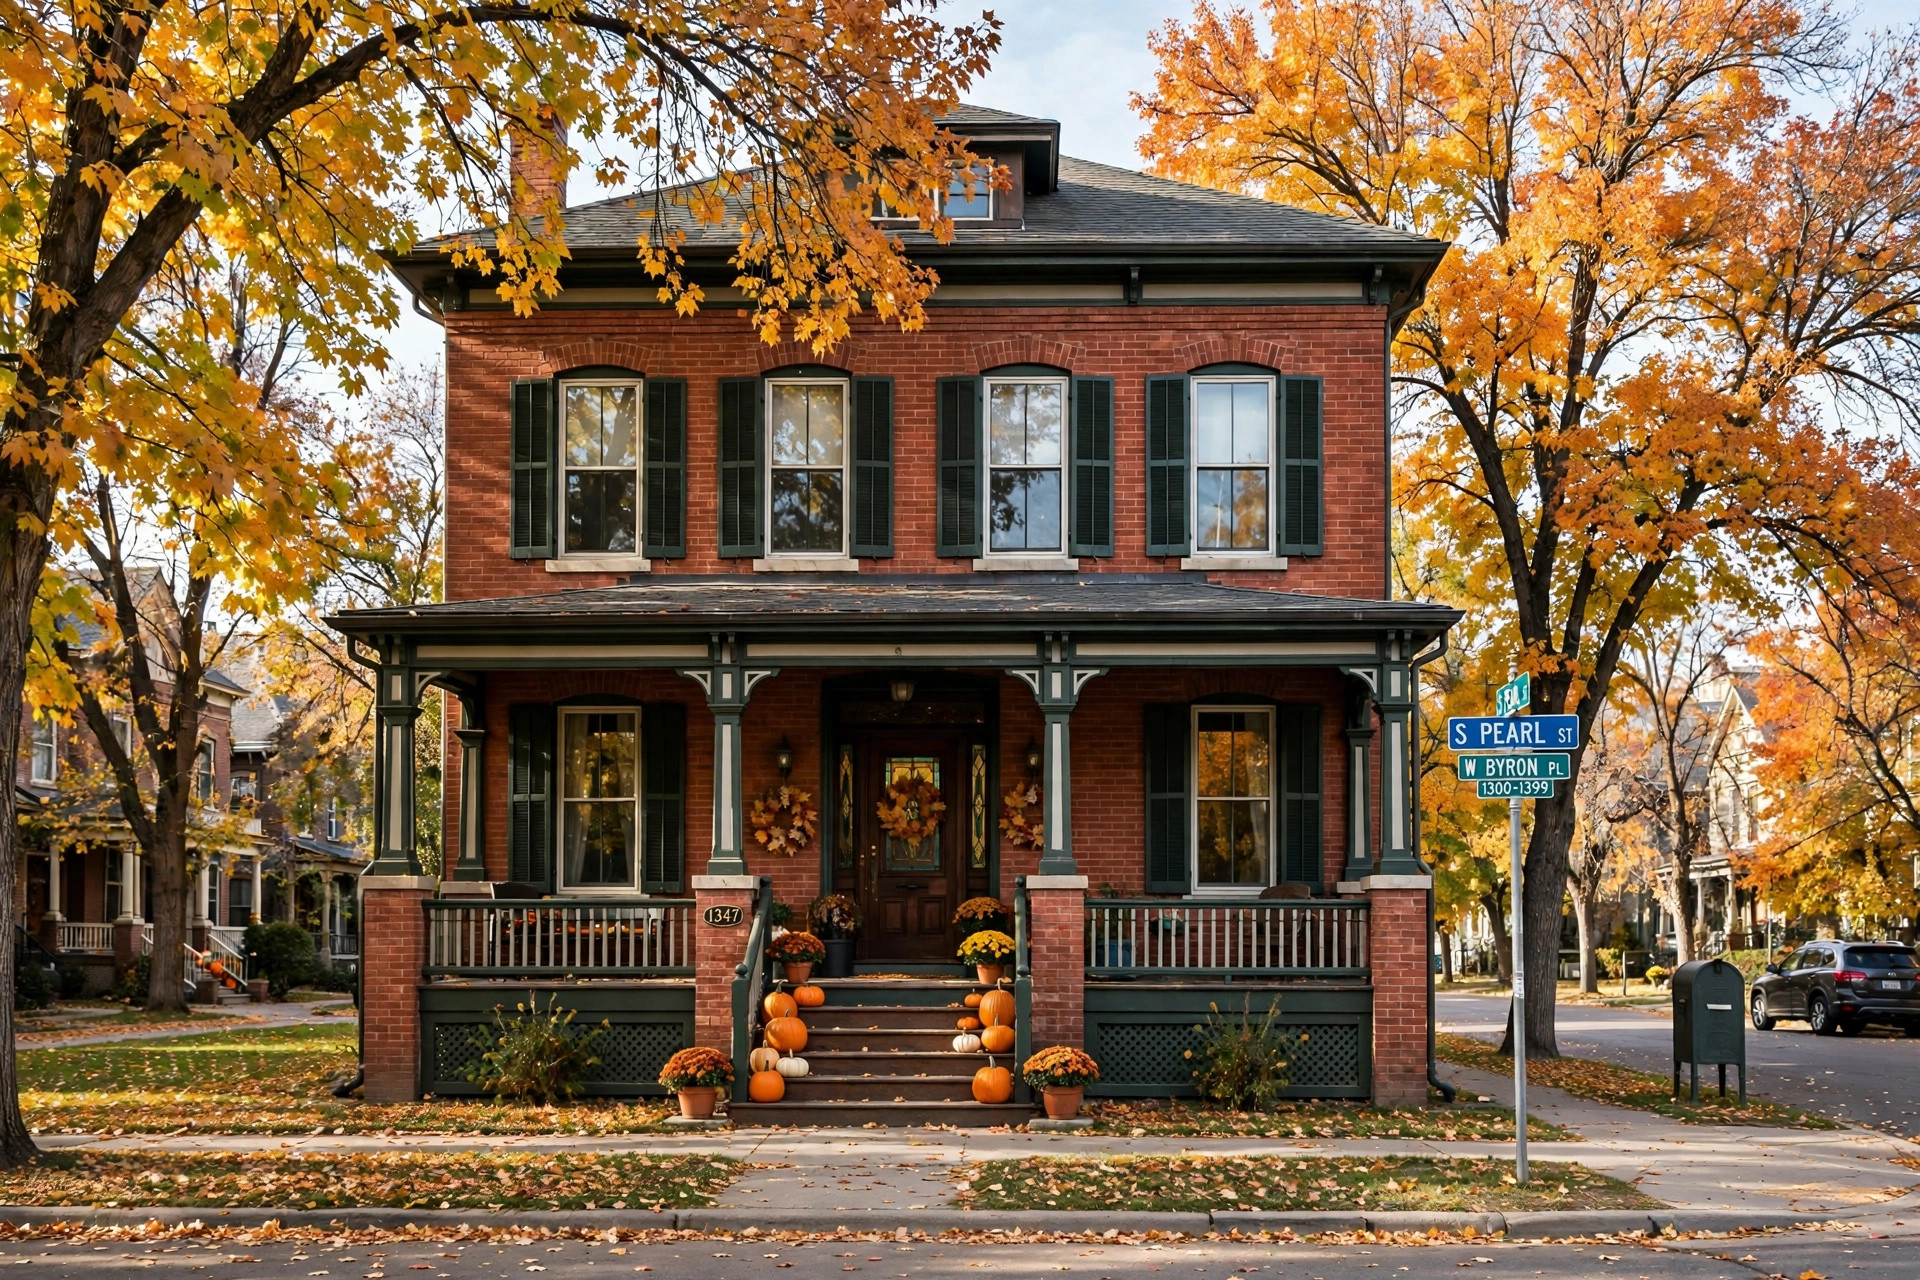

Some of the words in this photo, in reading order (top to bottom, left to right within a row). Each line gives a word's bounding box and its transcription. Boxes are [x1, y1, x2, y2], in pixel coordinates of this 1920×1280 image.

[1455, 722, 1467, 745] S
[1480, 721, 1546, 744] PEARL
[1558, 728, 1573, 743] ST
[1464, 758, 1477, 777] W
[1486, 757, 1538, 777] BYRON
[1548, 762, 1564, 776] PL
[1482, 781, 1549, 795] 1300-1399
[709, 908, 739, 923] 1347
